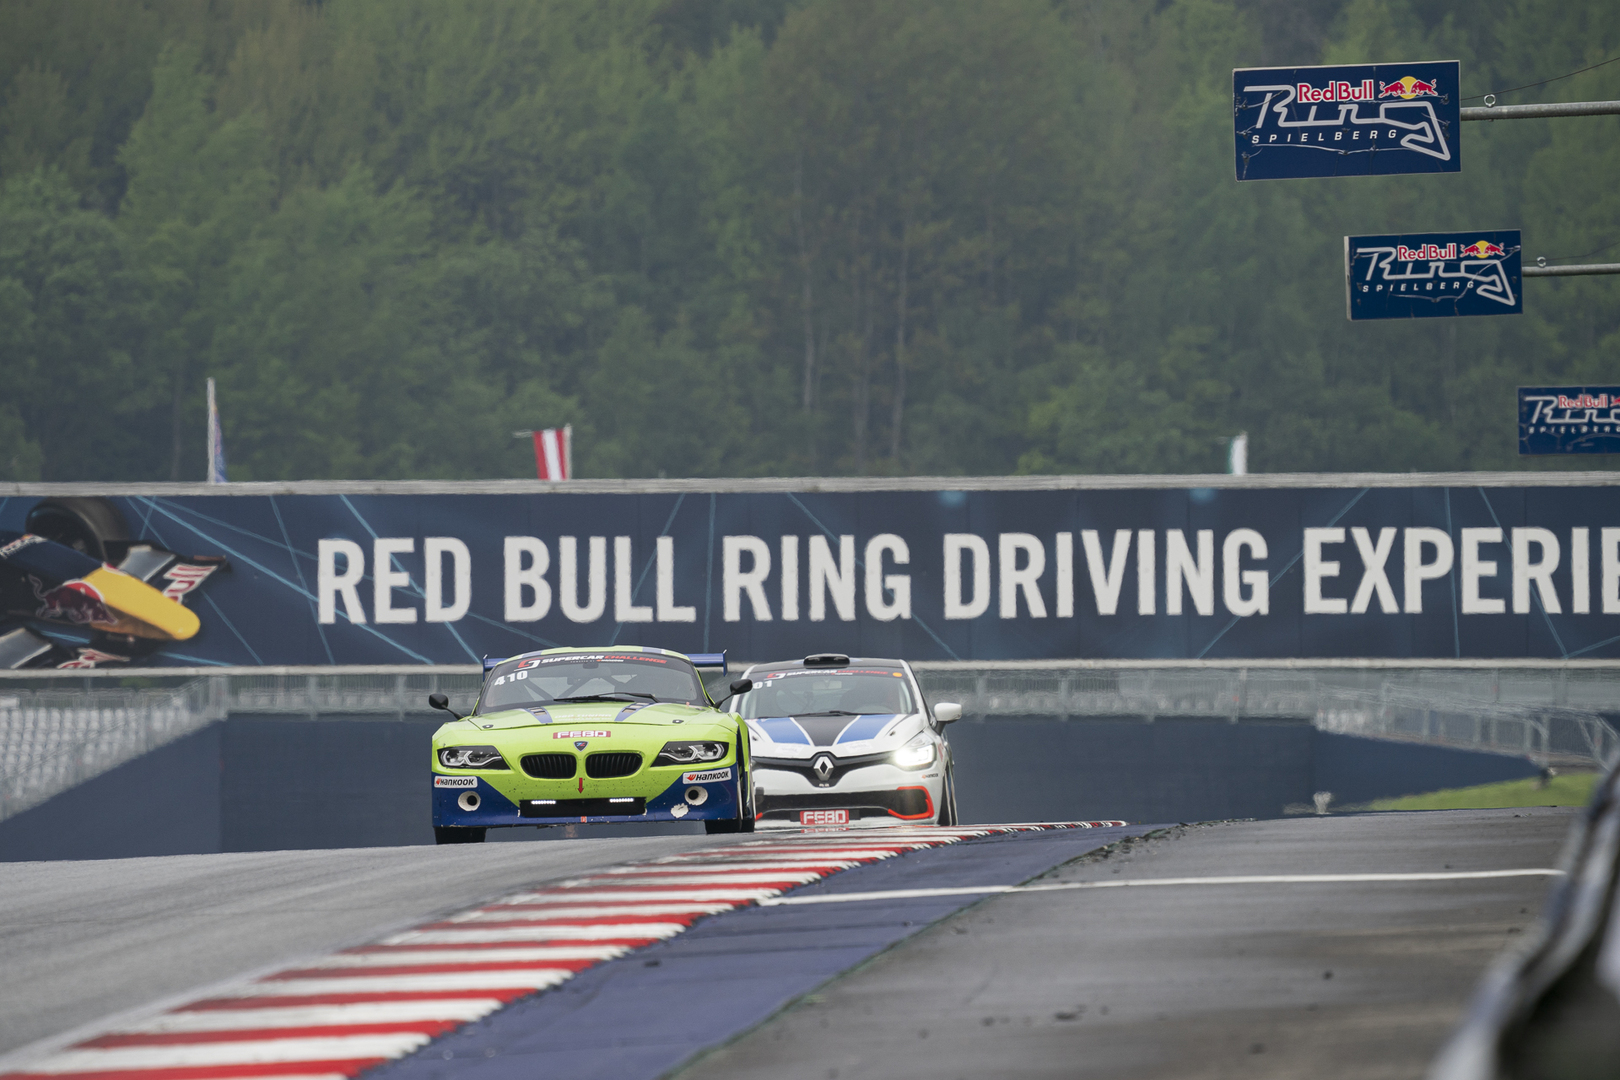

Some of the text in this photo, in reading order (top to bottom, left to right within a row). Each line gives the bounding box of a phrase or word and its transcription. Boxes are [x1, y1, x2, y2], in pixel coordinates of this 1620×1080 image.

[1298, 80, 1374, 103] Red Bull
[1251, 129, 1397, 144] SPIELBERG
[1398, 243, 1457, 261] Red Bull
[1362, 280, 1475, 293] SPIELBERG
[1558, 394, 1608, 409] Red Bull
[317, 535, 473, 625] RED
[503, 535, 697, 623] BULL
[722, 533, 912, 622] RING
[943, 528, 1269, 619] DRIVING
[541, 655, 605, 664] SUPERCAR
[604, 655, 668, 664] CHALLENGE
[494, 670, 528, 686] 410
[696, 771, 730, 781] Hankook
